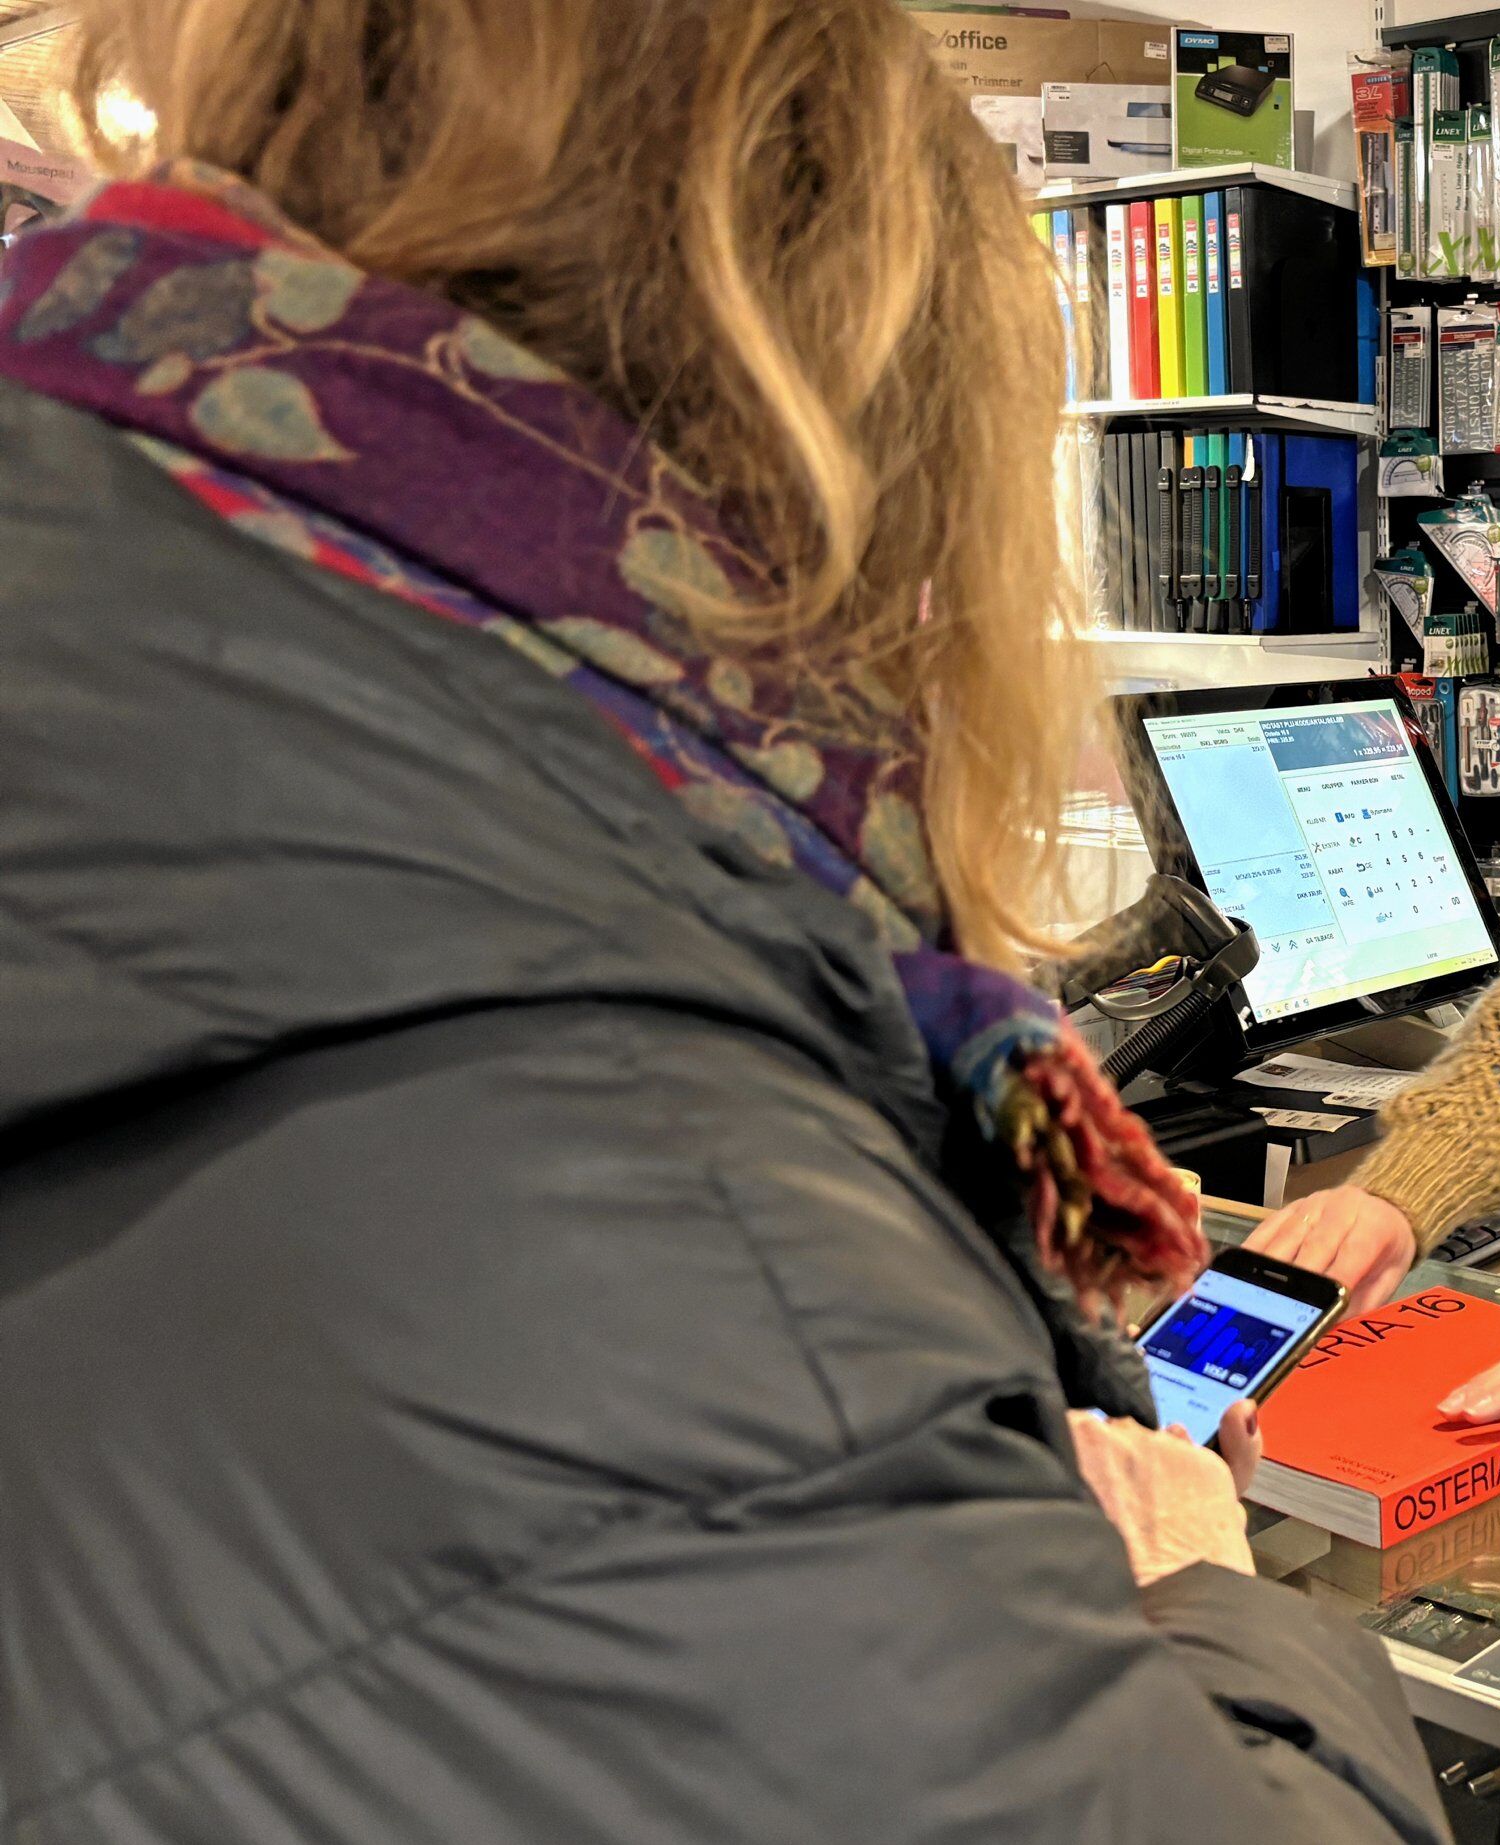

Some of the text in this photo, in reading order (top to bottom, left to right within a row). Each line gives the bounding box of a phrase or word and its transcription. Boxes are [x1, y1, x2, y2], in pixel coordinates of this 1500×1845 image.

[1184, 37, 1215, 45] DYMO
[1435, 127, 1462, 136] LINEX
[1428, 627, 1452, 636] LINEX
[1398, 1293, 1467, 1319] 16
